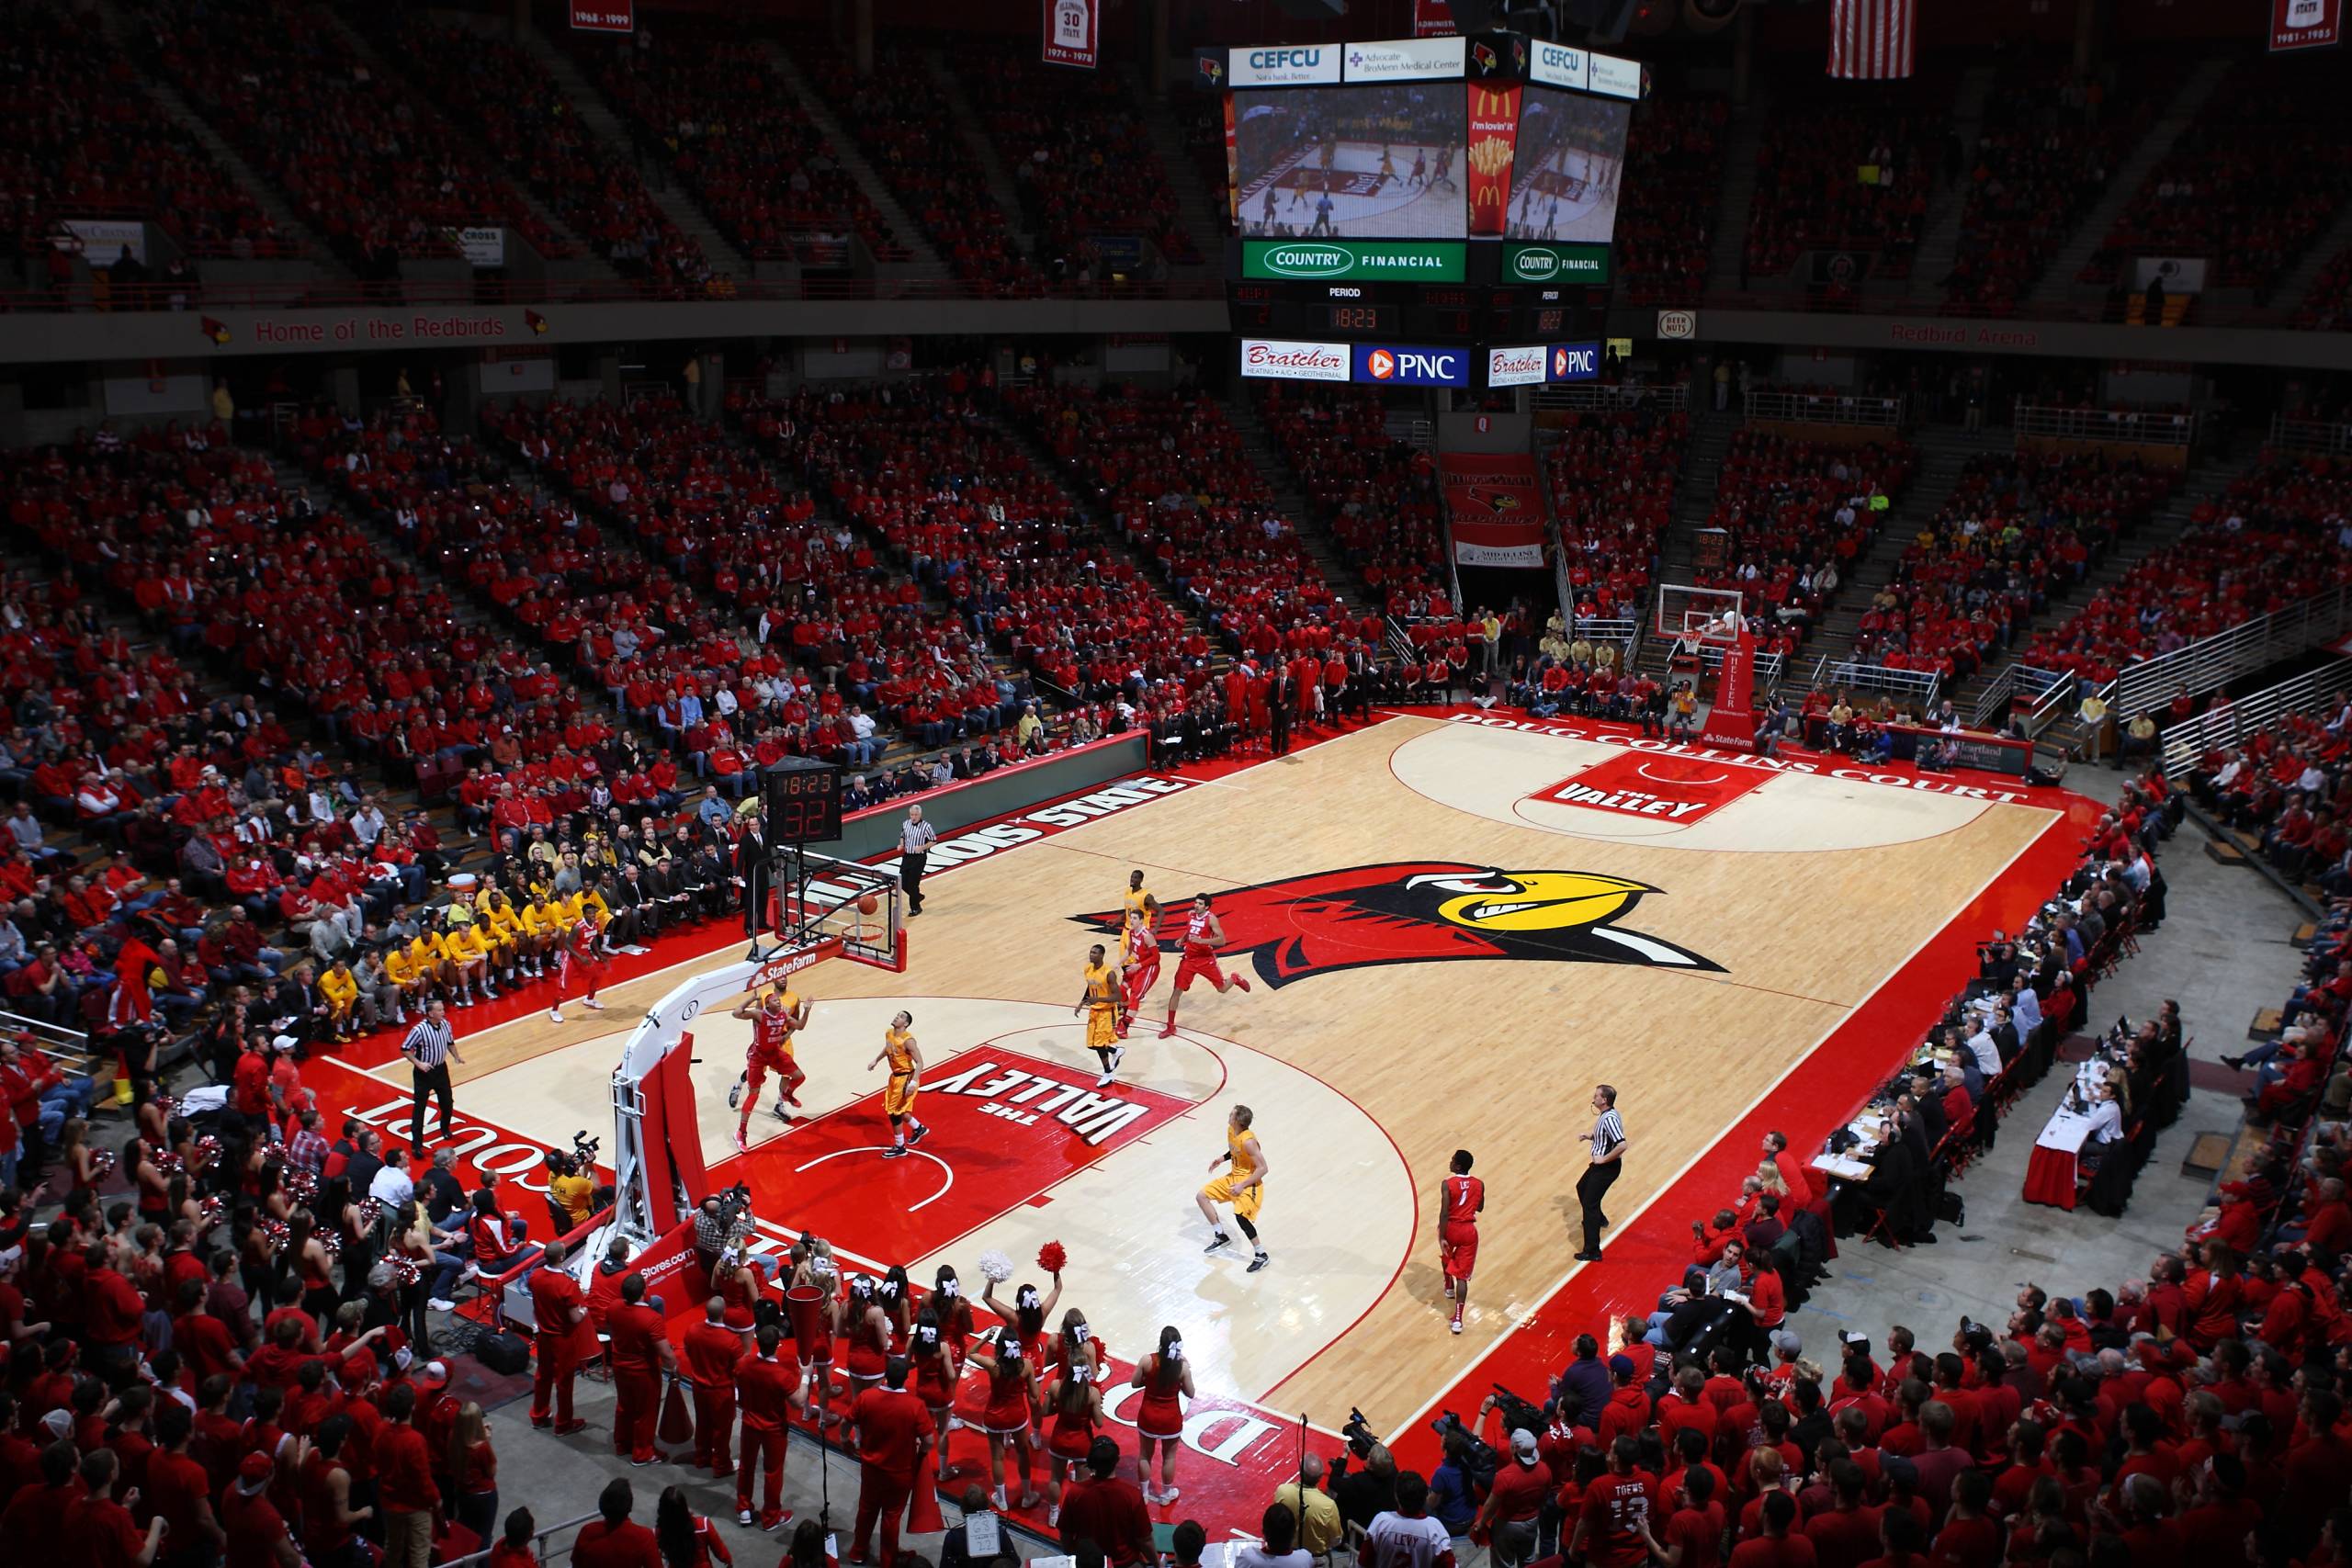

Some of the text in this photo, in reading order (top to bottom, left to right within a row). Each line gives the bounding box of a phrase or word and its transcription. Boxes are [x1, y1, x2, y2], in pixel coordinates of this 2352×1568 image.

[1064, 12, 1080, 27] 30
[1250, 50, 1320, 69] CEFCU
[1364, 52, 1401, 62] Advocate
[1543, 47, 1578, 71] CEFCU
[1400, 61, 1432, 72] Medical
[1434, 60, 1461, 70] Center
[465, 231, 497, 240] CROSS
[1276, 252, 1443, 267] COUNTRY FINANCIAL
[1520, 255, 1599, 270] COUNTRY FINANCIAL
[1329, 288, 1361, 298] PERIOD
[1542, 291, 1559, 300] PERIOD
[1335, 308, 1376, 328] 18:23
[256, 318, 504, 342] Home of the Redbirds
[1667, 324, 1687, 333] NUTS
[1891, 324, 2037, 346] Redbird Arena
[1248, 344, 1343, 368] Bratcher
[1492, 349, 1542, 374] Bratcher
[1568, 350, 1593, 373] PNC
[1298, 369, 1343, 379] GEOTHERMAL
[1397, 354, 1455, 379] PNC
[1478, 417, 1487, 433] Q
[1727, 657, 1738, 708] HELLER
[1956, 741, 2001, 756] Heartland
[1447, 713, 2028, 802] DOUG COLLINS COURT
[782, 773, 831, 795] 18:23
[1025, 776, 1188, 827] STATE
[1554, 783, 1707, 818] VALLEY
[1617, 789, 1658, 800] THE
[785, 800, 826, 838] 32
[1190, 926, 1201, 934] 22
[919, 1062, 1149, 1145] VALLEY
[978, 1101, 1040, 1126] THE
[1459, 1190, 1467, 1205] 1
[1614, 1482, 1645, 1497] TOEWS
[1394, 1533, 1419, 1547] LEVY
